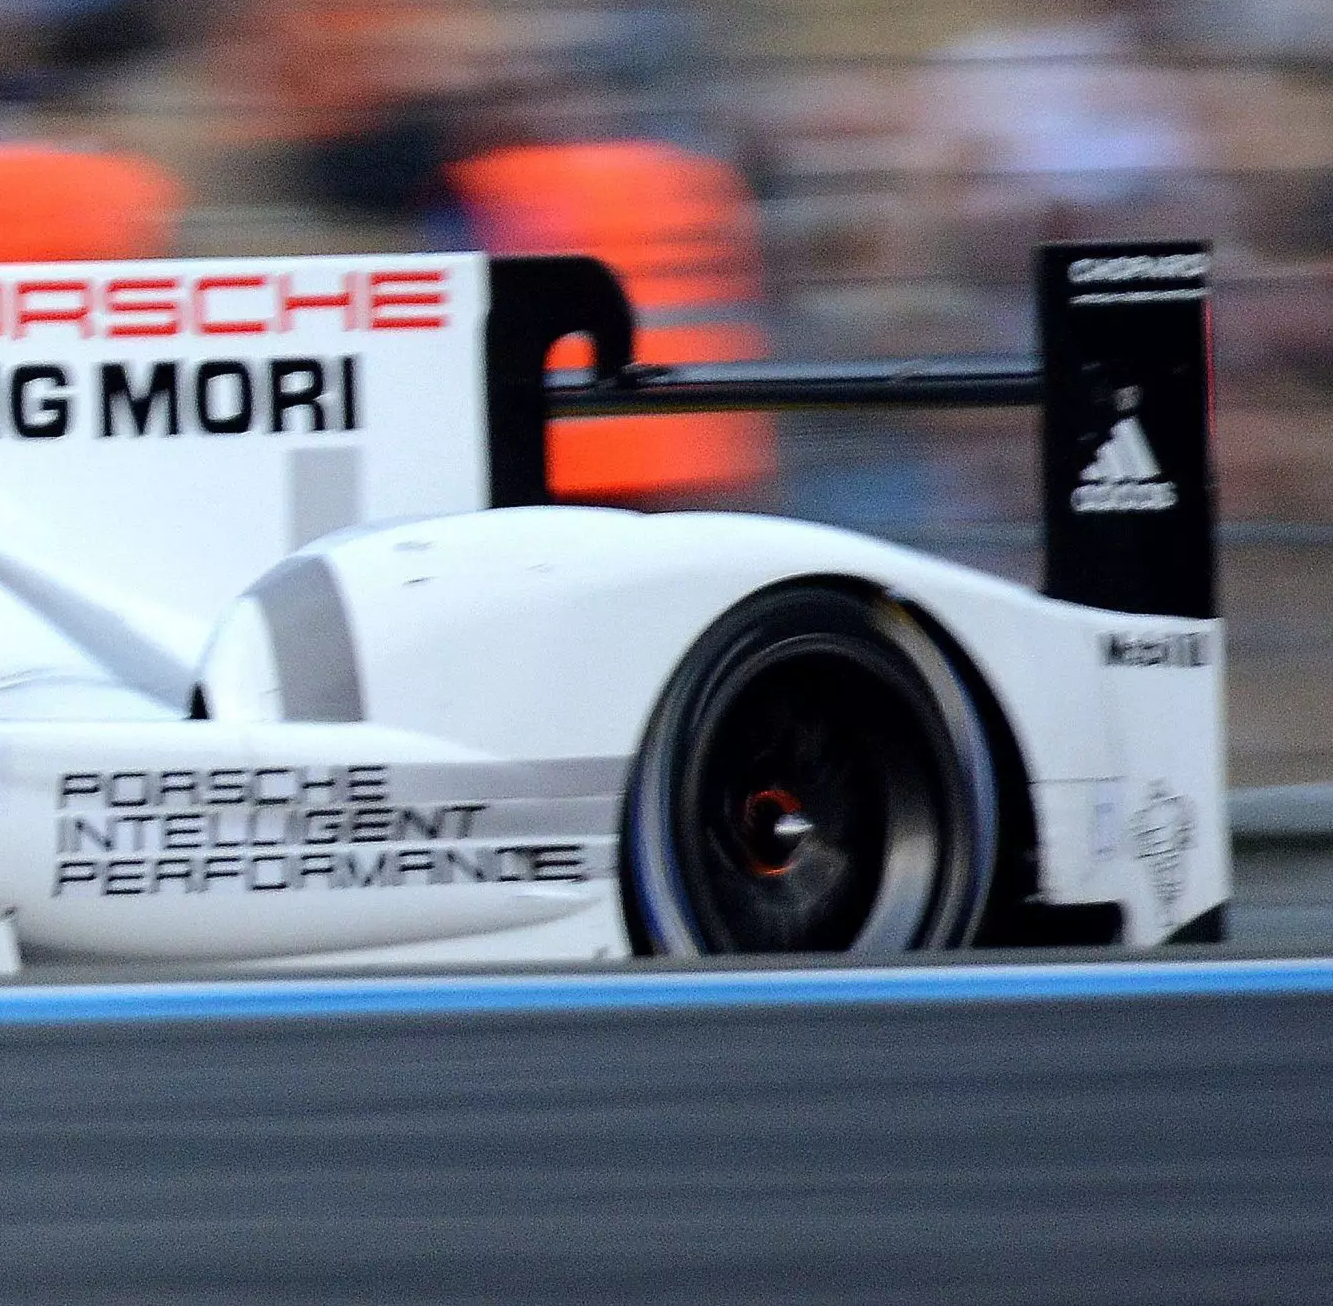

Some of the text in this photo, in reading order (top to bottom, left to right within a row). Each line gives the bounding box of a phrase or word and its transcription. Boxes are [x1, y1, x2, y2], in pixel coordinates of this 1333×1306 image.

[97, 355, 360, 439] MORI
[59, 764, 386, 809] PORSCHE
[59, 804, 486, 852] INTELLIGENT
[54, 844, 583, 895] PERFORMANCE
